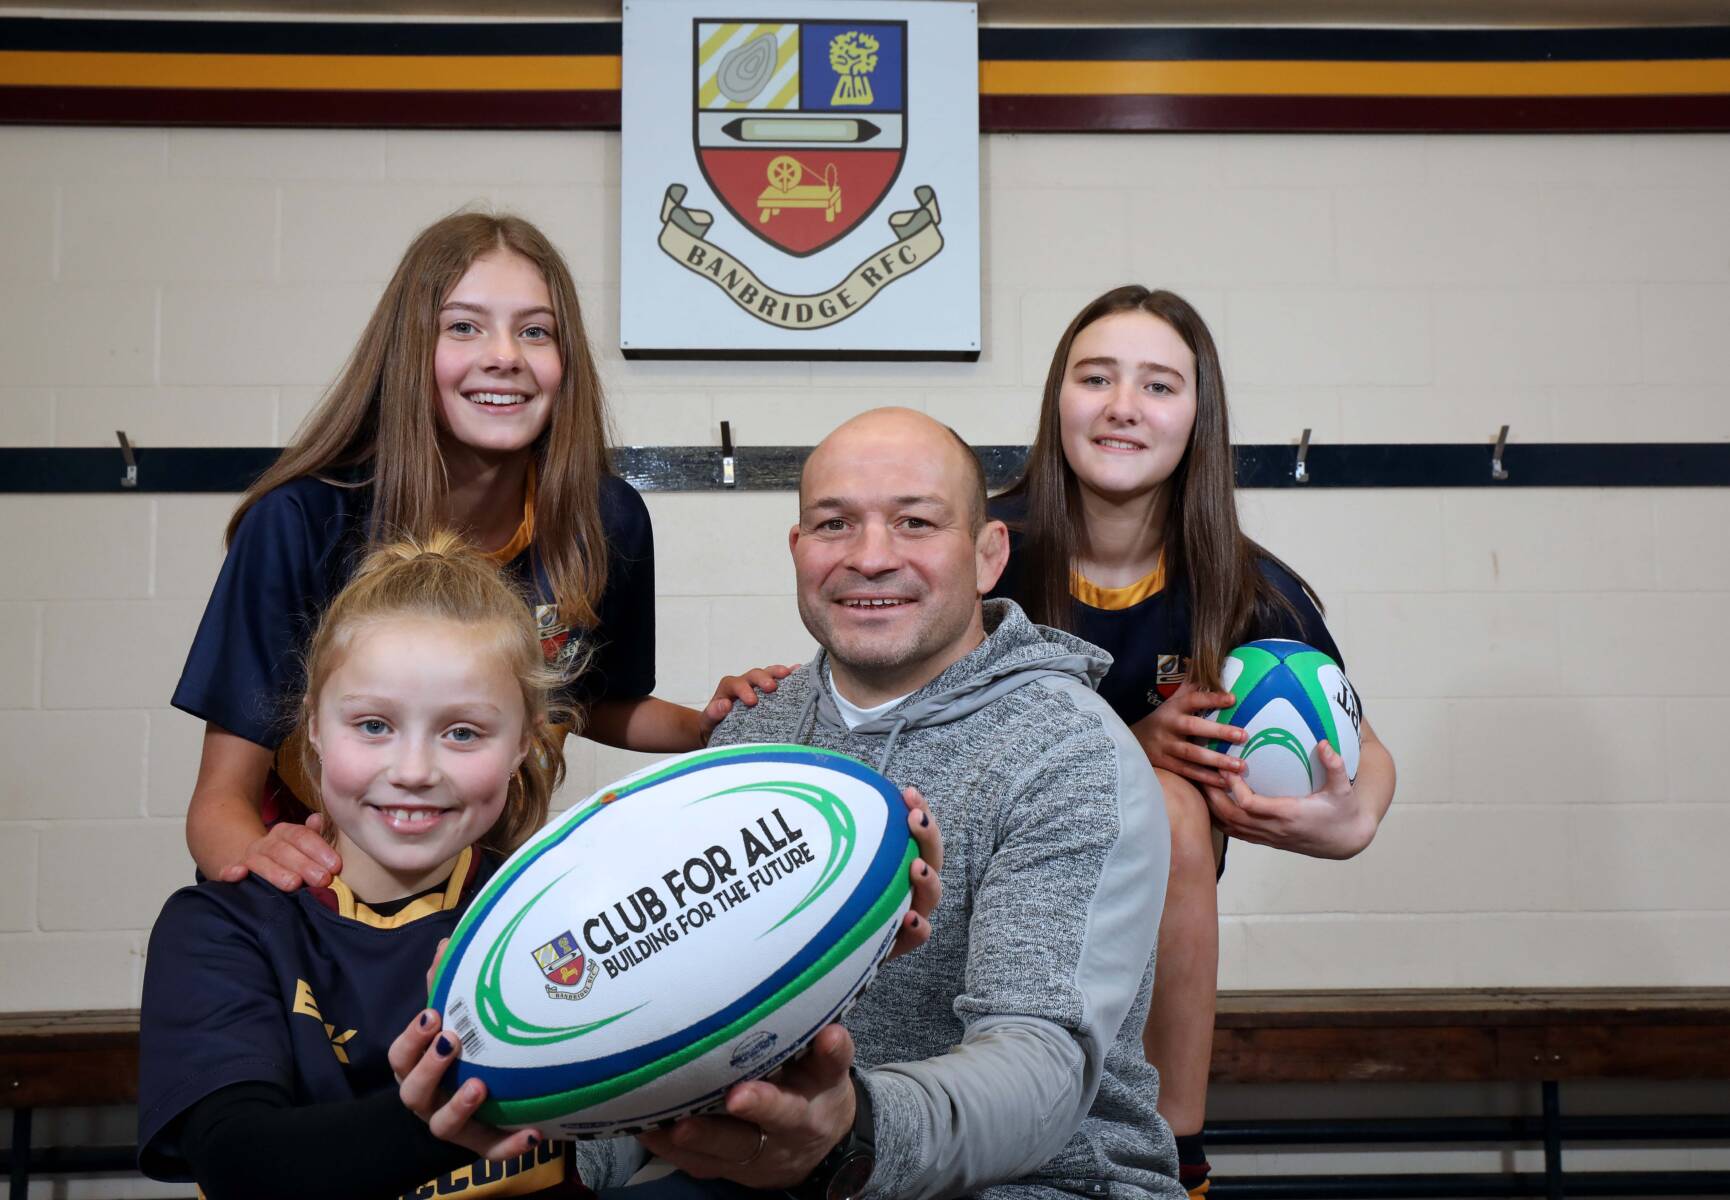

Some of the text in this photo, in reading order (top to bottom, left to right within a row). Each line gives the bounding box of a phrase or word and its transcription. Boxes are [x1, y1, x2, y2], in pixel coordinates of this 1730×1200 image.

[686, 244, 918, 323] BANBRIDGE RFC
[583, 808, 803, 955] CLUB FOR ALL
[602, 842, 815, 979] BUILDING FOR THE FUTURE
